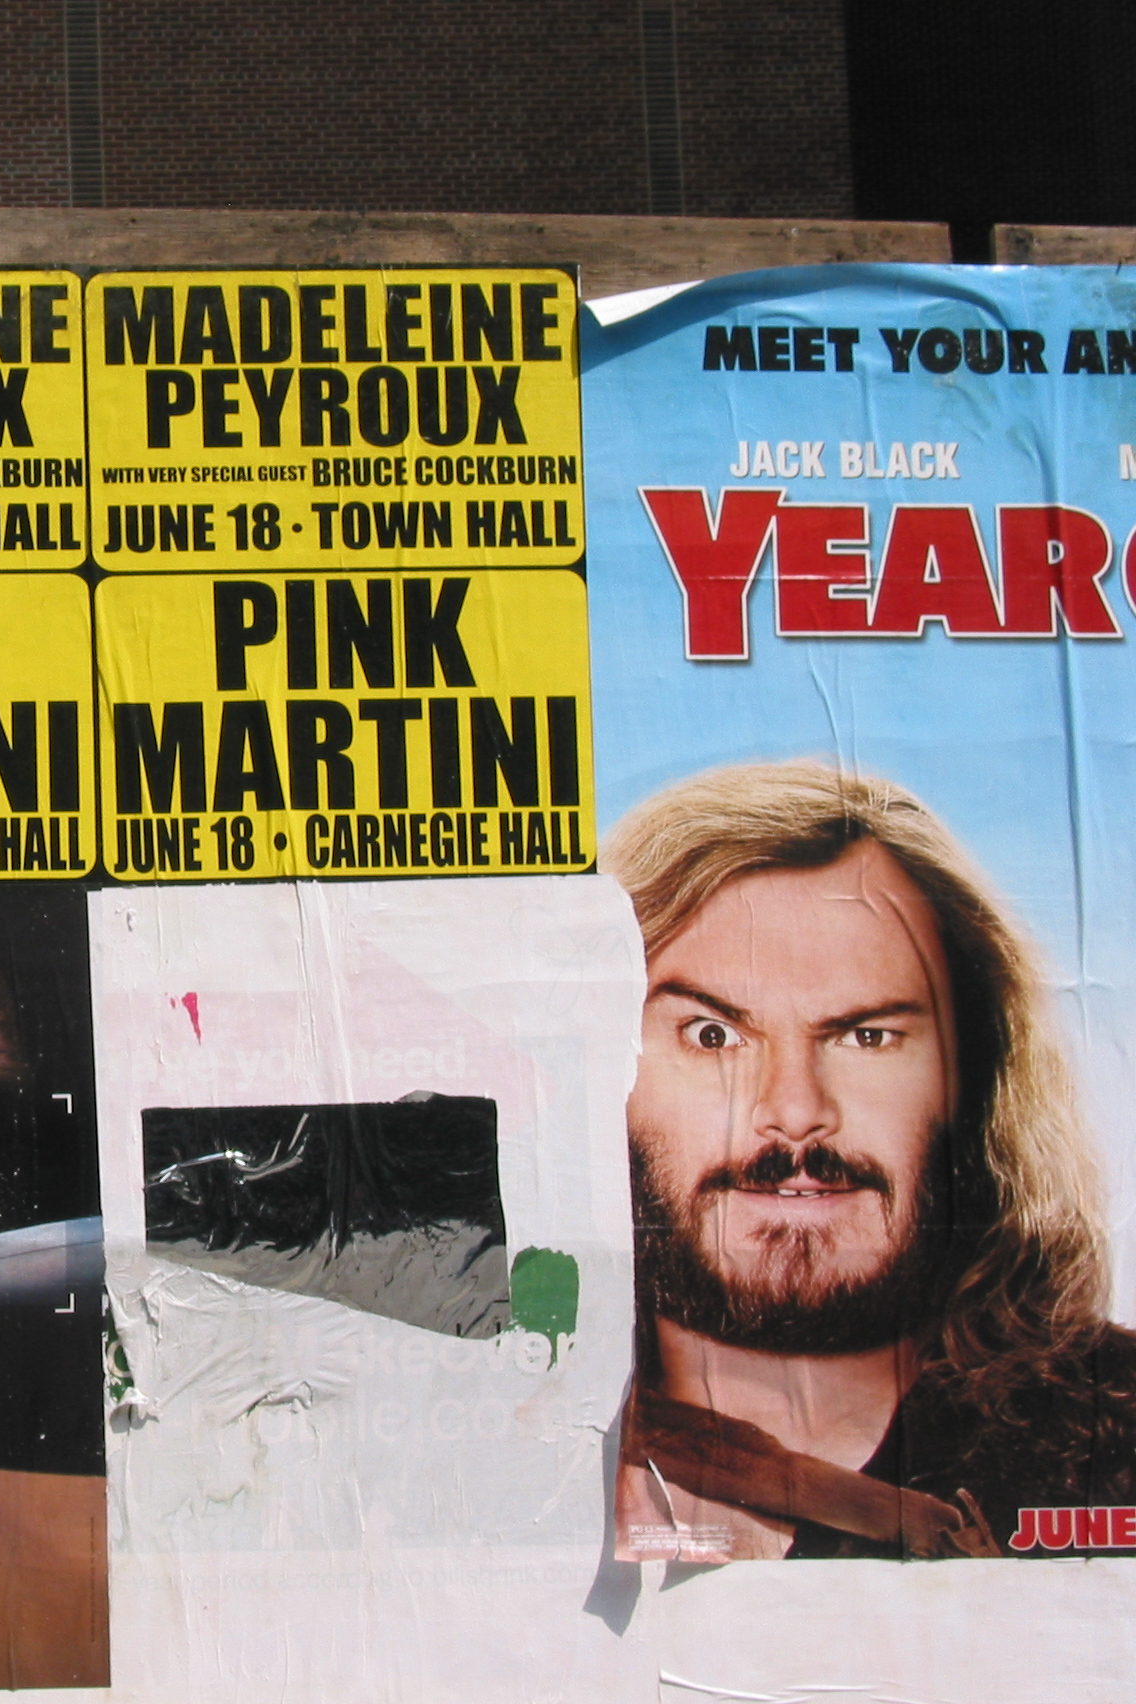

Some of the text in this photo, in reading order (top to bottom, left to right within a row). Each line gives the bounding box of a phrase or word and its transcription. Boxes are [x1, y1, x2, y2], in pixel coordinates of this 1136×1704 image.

[103, 283, 562, 366] MADELEINE
[702, 326, 860, 371] MEET
[879, 328, 1048, 374] YOUR
[146, 366, 528, 448] PEYROUX
[102, 455, 577, 487] WITH VERY SPECIAL GUEST BRUCE COCKBURN
[730, 441, 960, 479] JACK BLACK
[104, 500, 575, 552] JUNE 18 TOWN HALL
[638, 486, 1124, 660] YEAR
[213, 578, 477, 691] PINK
[113, 696, 581, 813] MARTINI
[114, 812, 586, 873] JUNE 18 CARNEGIE HALL
[1008, 1507, 1136, 1551] JUNE
